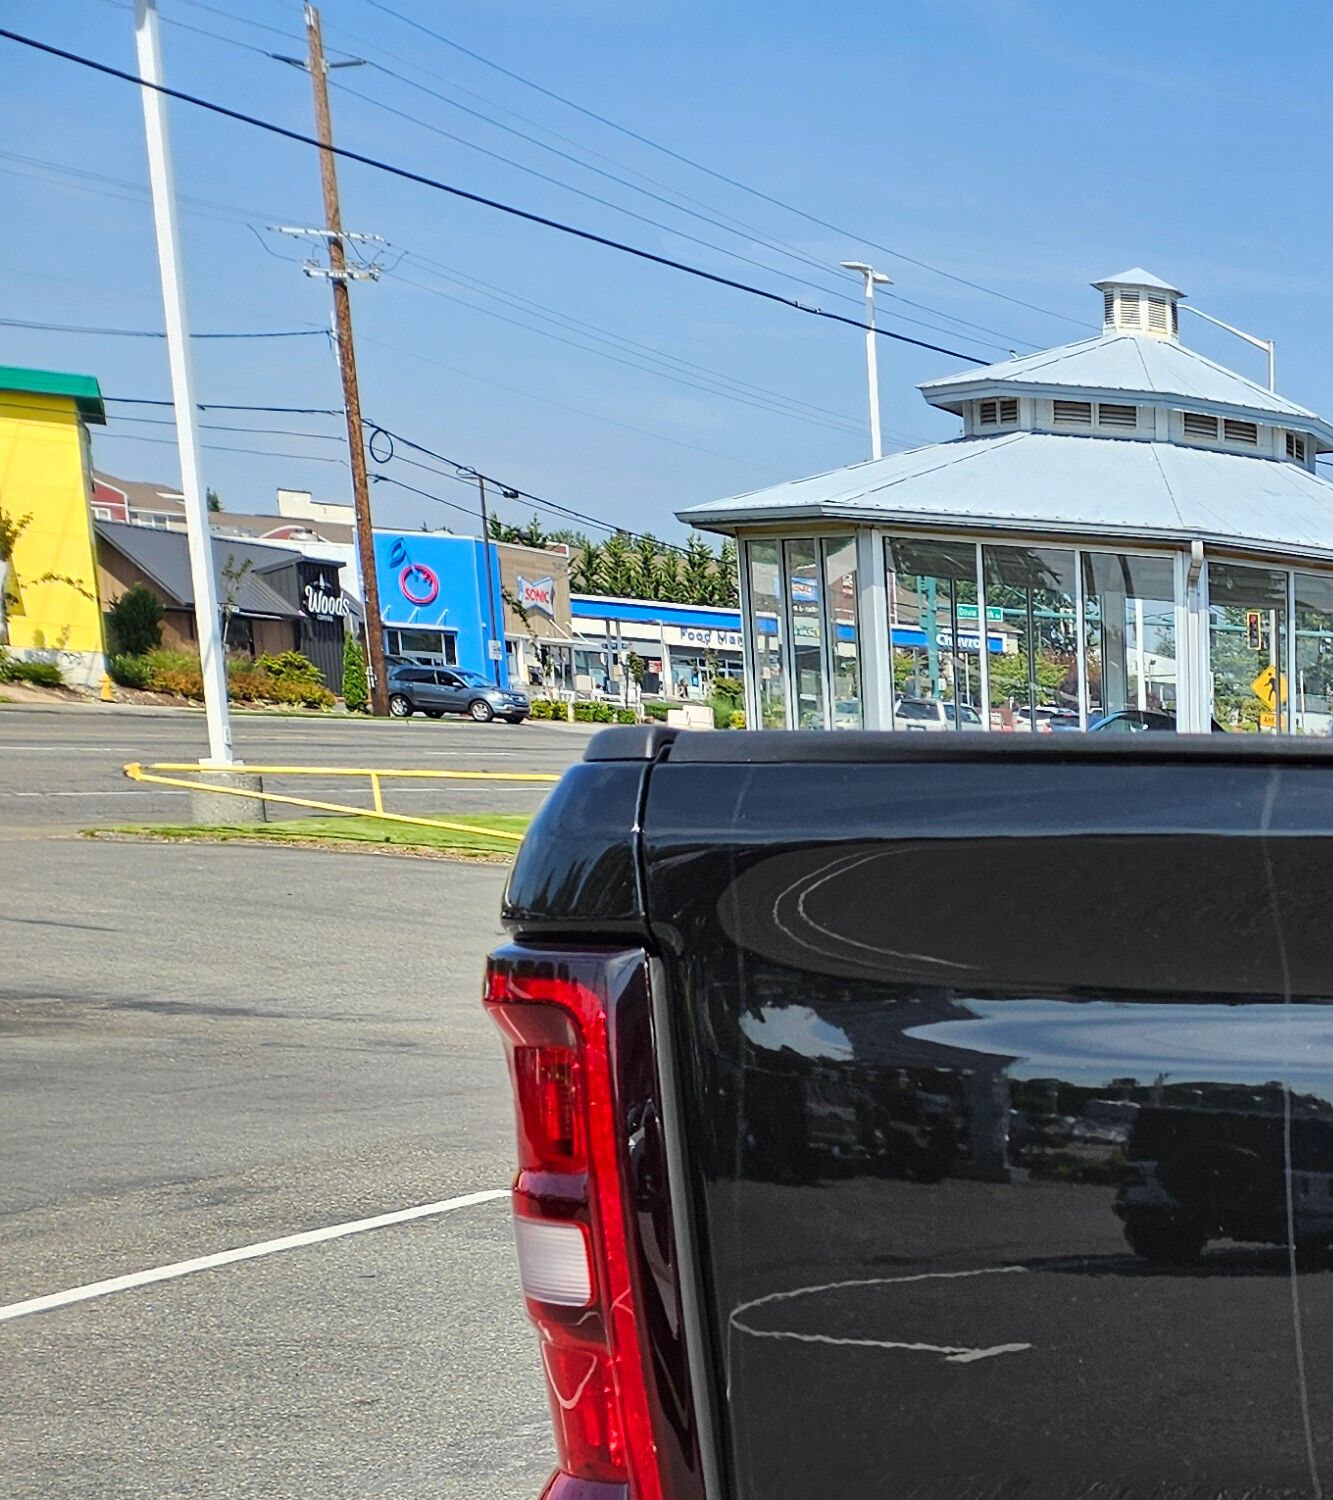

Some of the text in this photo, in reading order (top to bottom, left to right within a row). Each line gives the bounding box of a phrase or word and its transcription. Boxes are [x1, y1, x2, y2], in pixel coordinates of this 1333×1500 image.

[305, 585, 350, 616] Woods
[525, 588, 549, 603] SONIC
[680, 625, 711, 644] Food
[934, 633, 990, 653] Chvro
